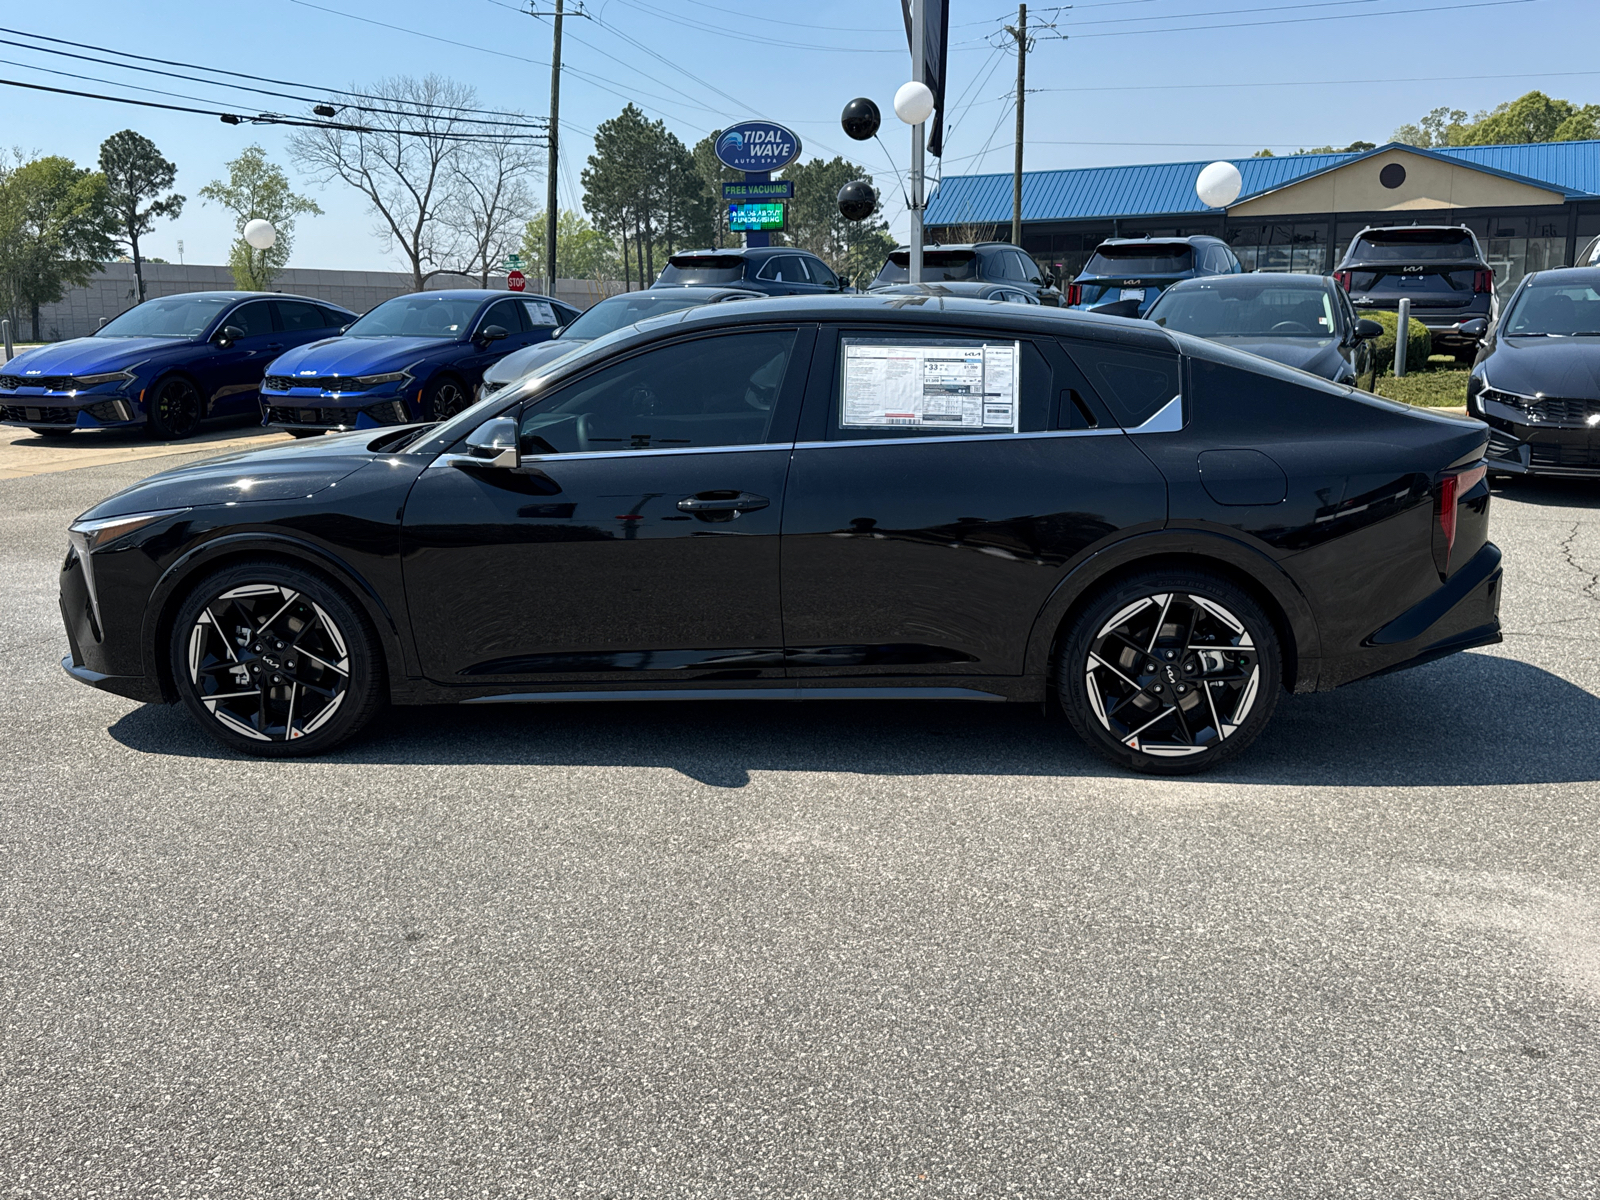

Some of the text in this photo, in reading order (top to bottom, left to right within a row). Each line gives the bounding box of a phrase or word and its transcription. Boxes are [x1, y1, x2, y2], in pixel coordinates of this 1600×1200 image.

[744, 130, 782, 143] TIDAL
[750, 144, 790, 156] WAVE
[725, 184, 787, 195] FREE VACUUMS
[509, 278, 525, 287] STOP
[1220, 716, 1261, 756] KUMHO
